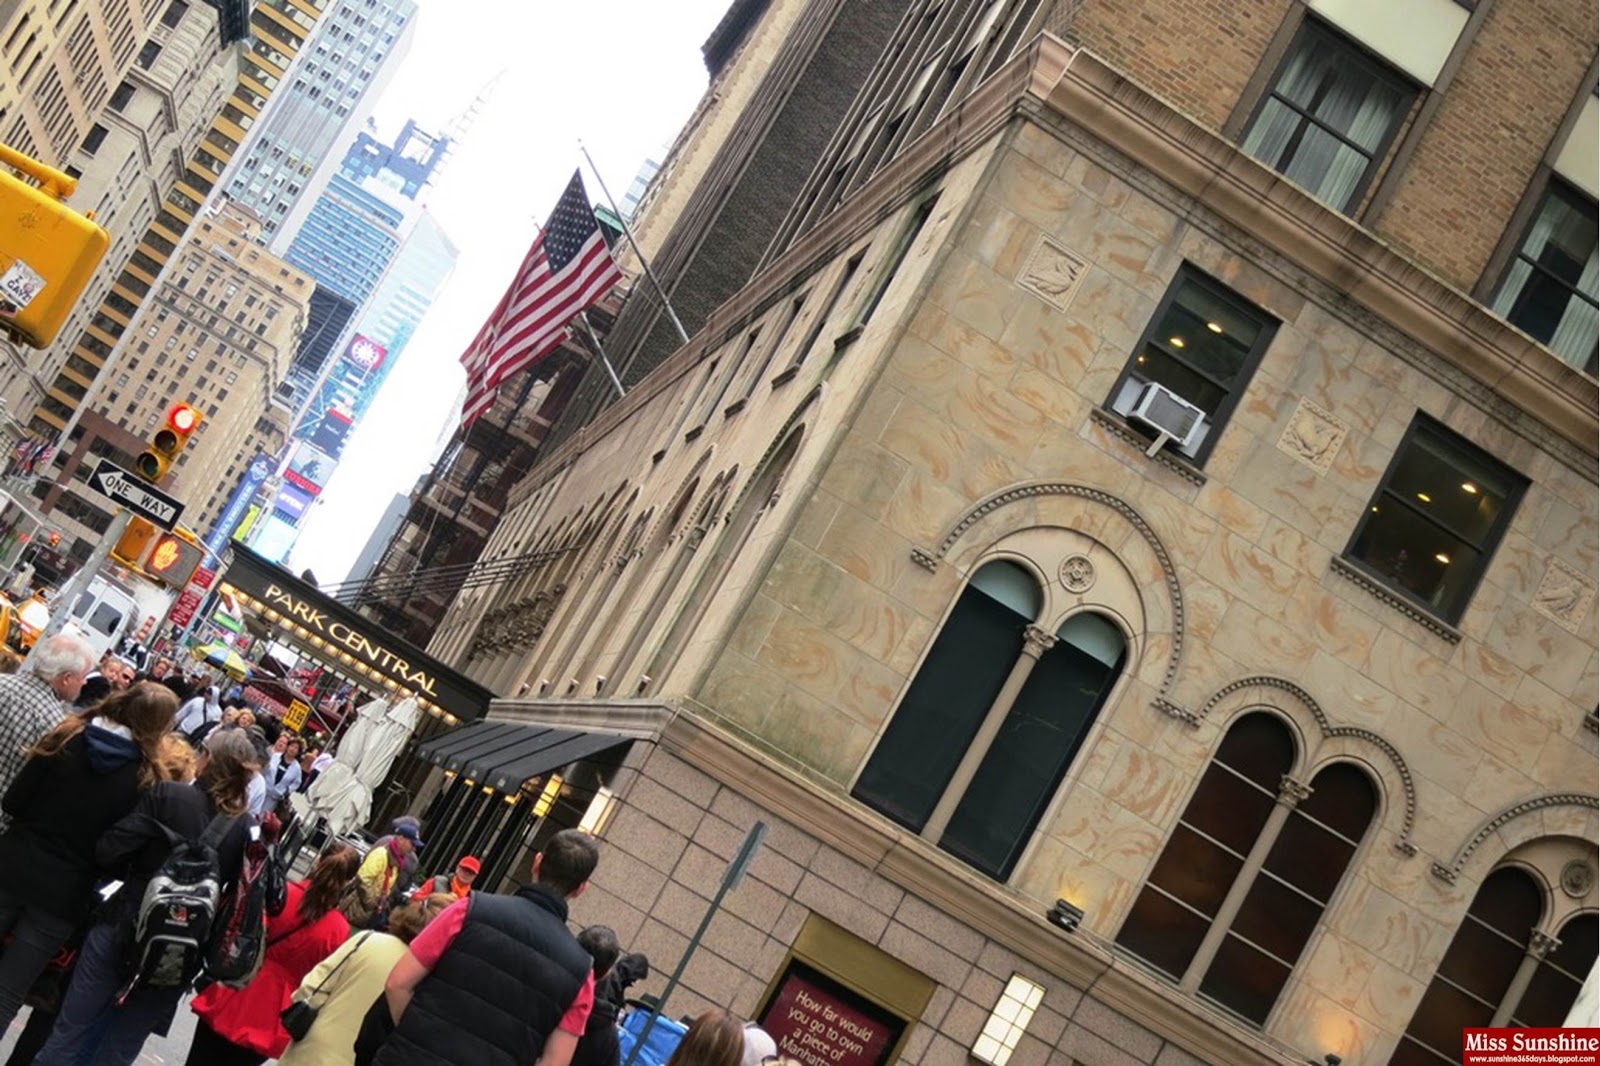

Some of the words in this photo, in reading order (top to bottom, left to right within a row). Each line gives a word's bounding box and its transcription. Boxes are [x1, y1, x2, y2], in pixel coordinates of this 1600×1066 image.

[105, 475, 132, 497] ONE
[140, 494, 169, 517] WAY
[264, 583, 328, 631] PARK
[329, 622, 438, 697] CENTRAL
[787, 1006, 811, 1025] you
[808, 1019, 826, 1034] go
[826, 1027, 839, 1041] to
[838, 1036, 864, 1056] own
[795, 990, 822, 1013] How
[822, 1005, 839, 1022] far
[839, 1017, 874, 1042] would
[792, 1027, 803, 1039] a
[801, 1032, 831, 1055] piece
[830, 1048, 847, 1062] of
